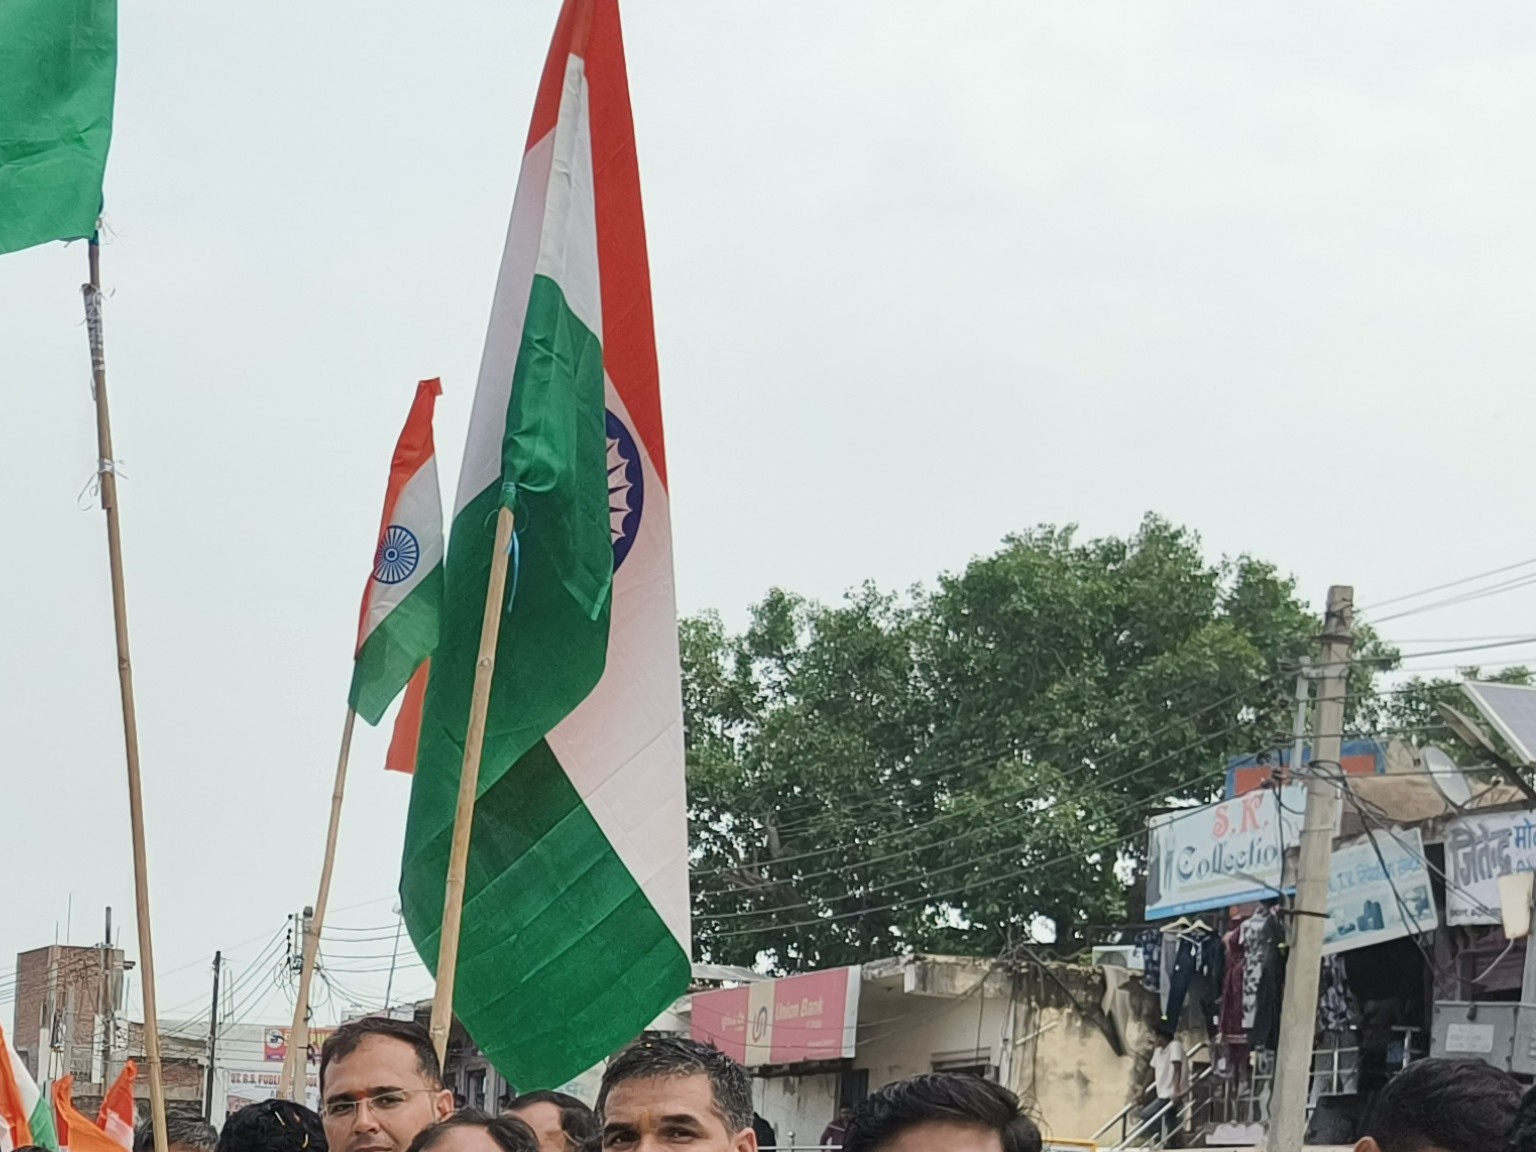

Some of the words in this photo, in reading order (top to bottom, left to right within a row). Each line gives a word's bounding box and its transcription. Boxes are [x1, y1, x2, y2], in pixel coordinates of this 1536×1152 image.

[1514, 816, 1536, 850] मो
[1177, 837, 1279, 883] Collectio
[775, 1001, 799, 1021] Union
[800, 995, 824, 1018] Bank
[258, 1073, 282, 1086] PUBLI
